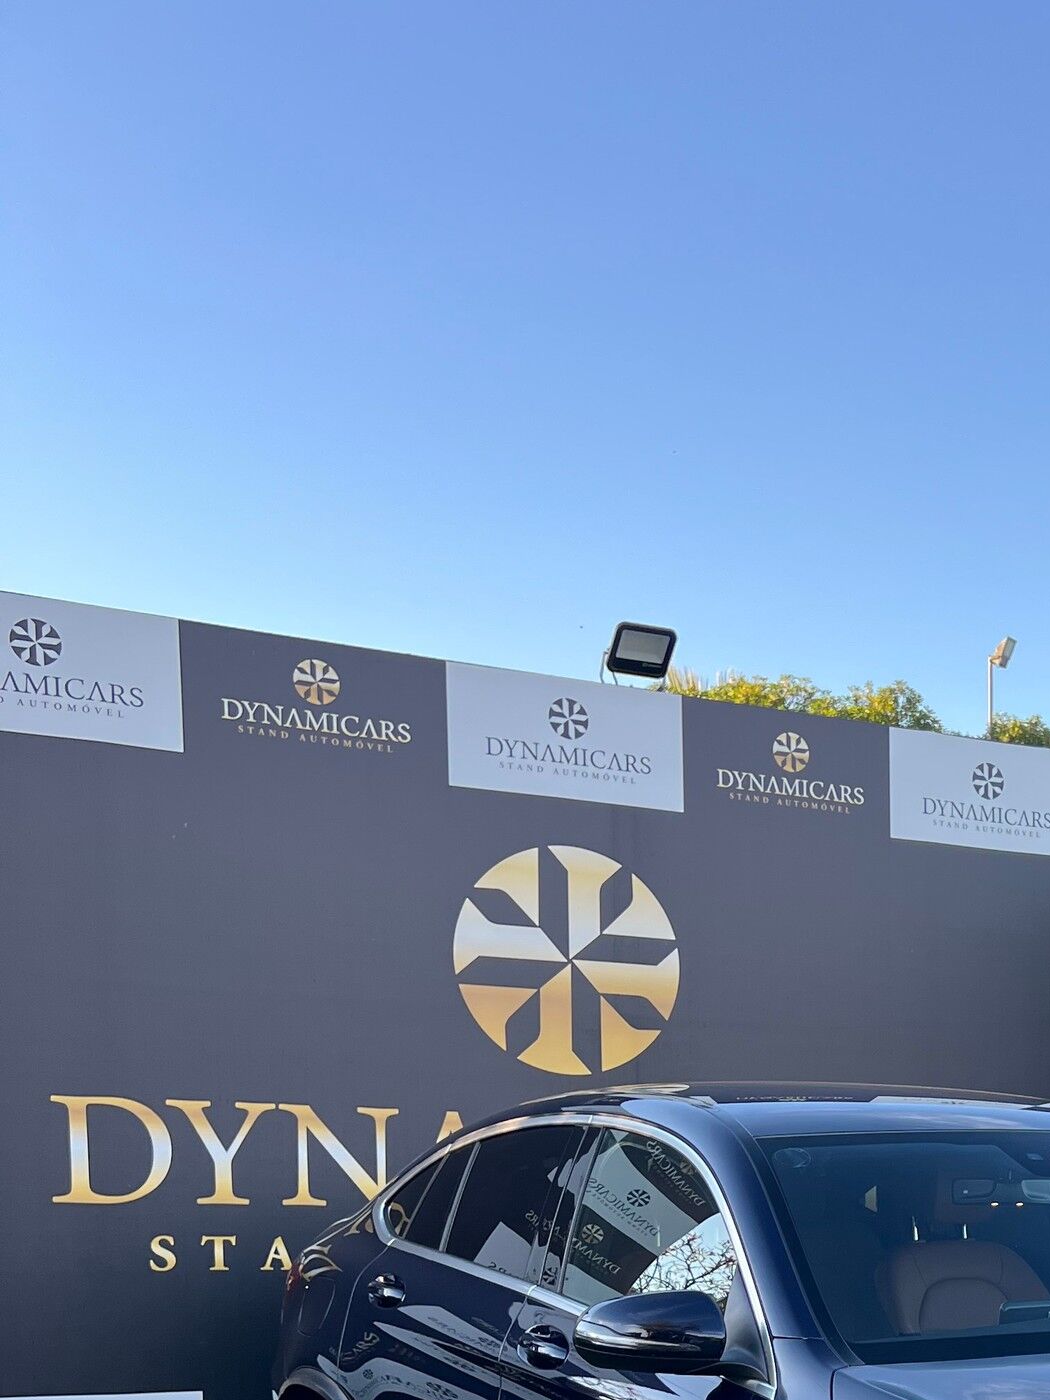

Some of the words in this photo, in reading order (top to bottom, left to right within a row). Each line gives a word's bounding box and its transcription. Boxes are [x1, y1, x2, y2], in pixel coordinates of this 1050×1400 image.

[0, 671, 144, 708] AMICARS
[16, 698, 125, 719] AUTOMÓVEL
[221, 698, 411, 743] DYNAMICARS
[238, 725, 289, 739] STAND
[300, 734, 393, 753] AUTOMÓVEL
[486, 736, 652, 775] DYNAMICARS
[499, 761, 544, 773] STAND
[553, 768, 636, 785] AUTOMÓVEL
[717, 768, 865, 805] DYNAMICARS
[729, 792, 769, 805] STAND
[777, 799, 850, 814] AUTOMÓVEL
[933, 819, 968, 830] STAND
[149, 1235, 294, 1272] STA
